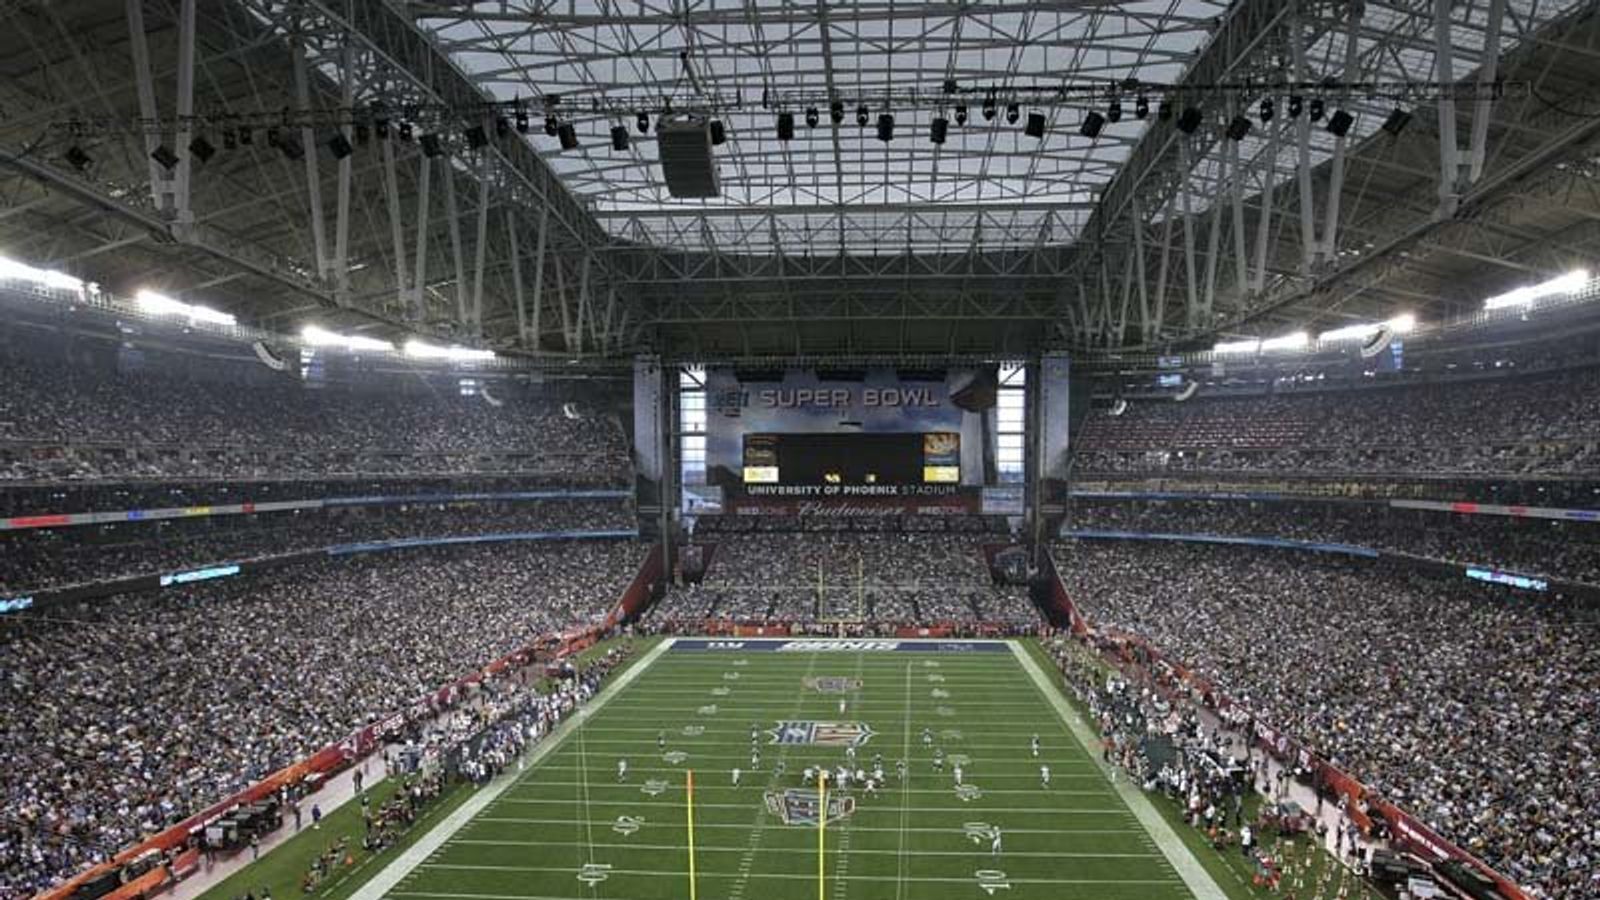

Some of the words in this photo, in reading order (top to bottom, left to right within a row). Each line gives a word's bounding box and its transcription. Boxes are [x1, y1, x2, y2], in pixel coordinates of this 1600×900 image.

[760, 389, 849, 408] SUPER
[863, 389, 939, 407] BOWL
[748, 485, 820, 495] UNIVERSITY
[824, 485, 840, 495] OF
[844, 485, 897, 495] PHOENIX
[902, 485, 956, 495] STADIUM
[799, 501, 905, 516] Budweiser
